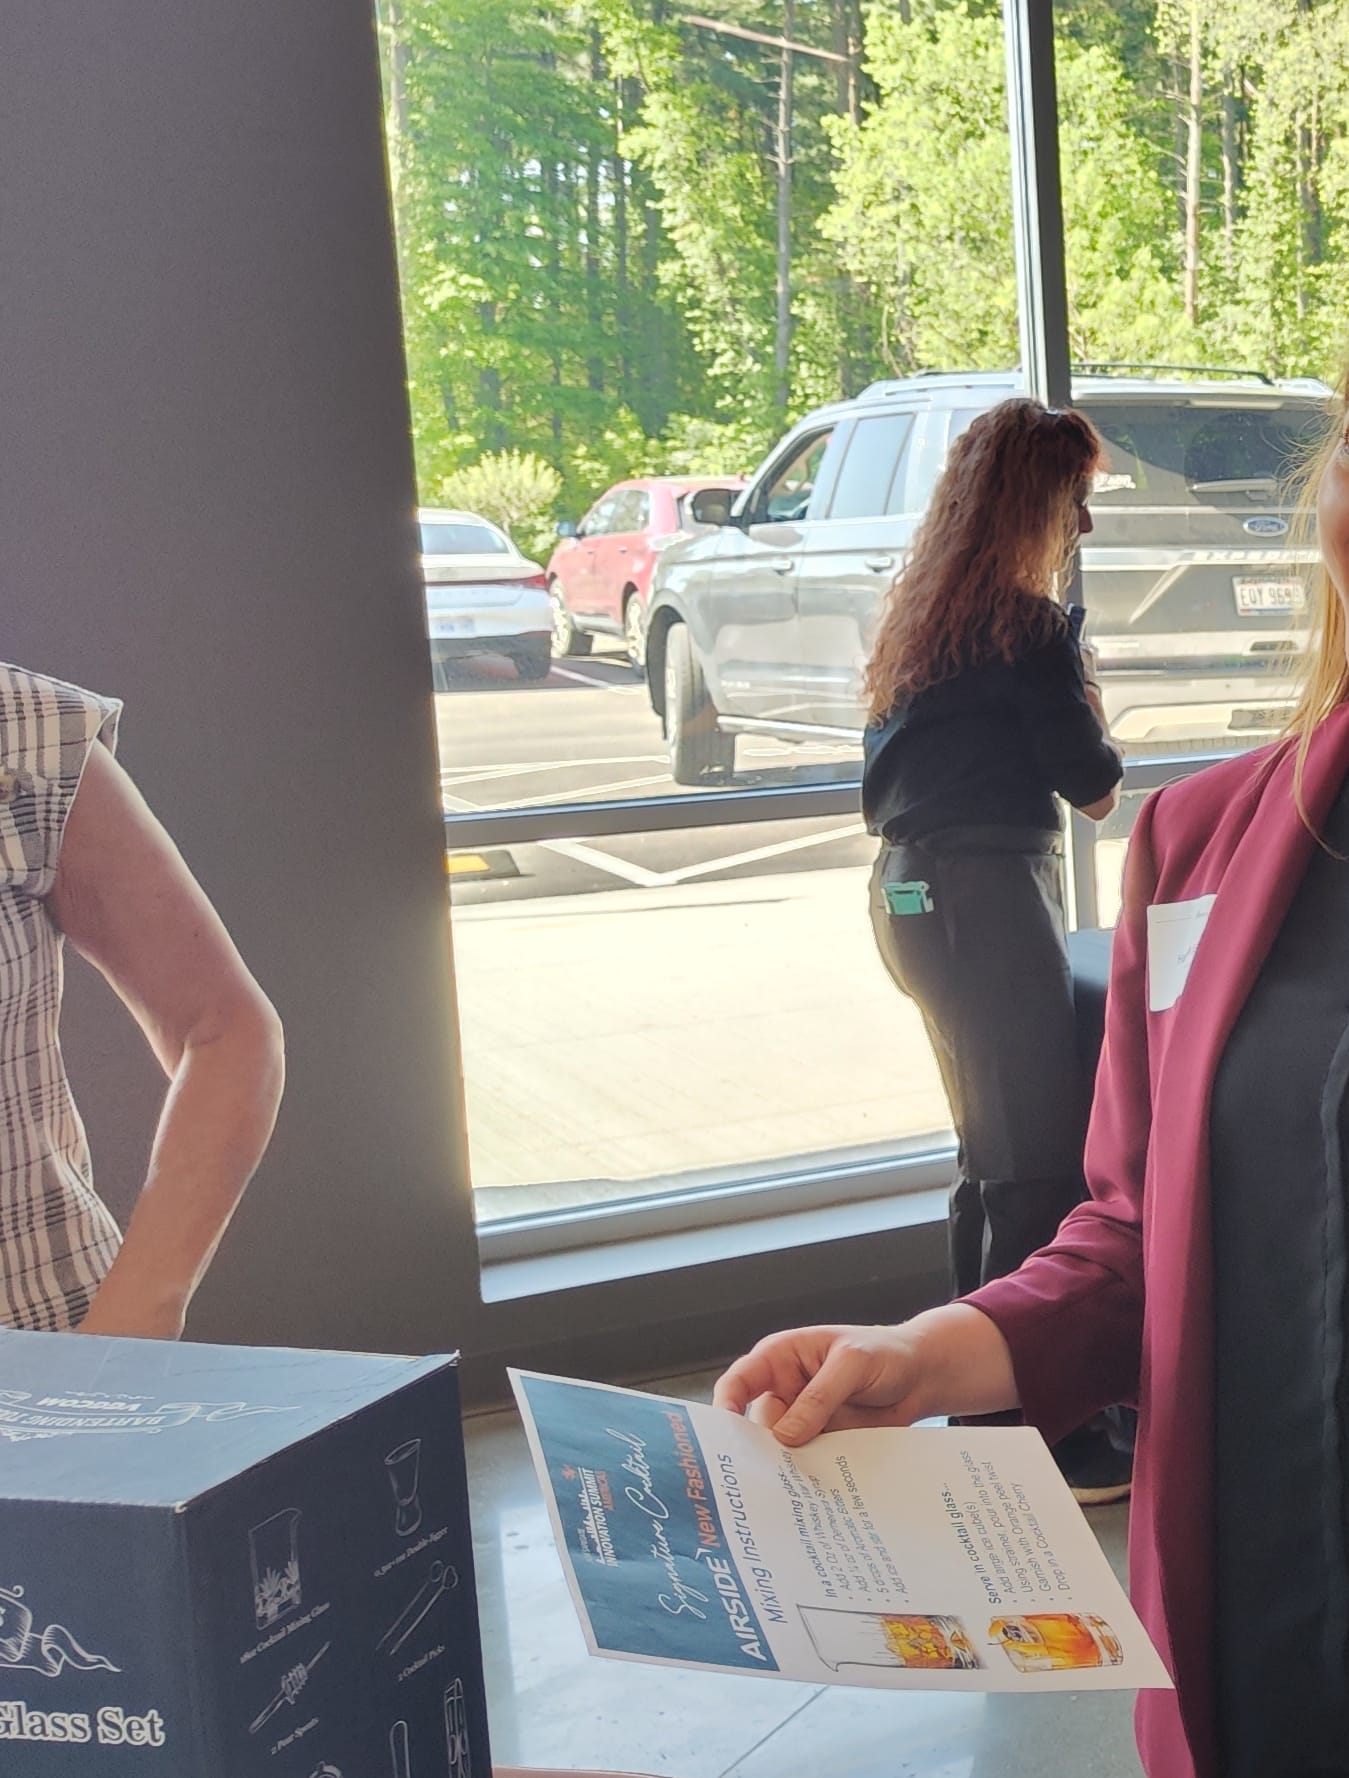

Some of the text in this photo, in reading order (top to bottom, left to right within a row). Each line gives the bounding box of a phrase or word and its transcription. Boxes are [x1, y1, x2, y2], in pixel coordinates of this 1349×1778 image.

[21, 1414, 167, 1427] BARTENDING
[959, 1450, 980, 1473] glass
[835, 1456, 858, 1492] seconds
[968, 1474, 983, 1488] the
[850, 1495, 866, 1510] few
[976, 1490, 992, 1506] into
[1011, 1482, 1030, 1511] Cherry
[582, 1467, 618, 1567] INNOVATION SUMMIT
[606, 1427, 709, 1620] Signature Cocktail
[792, 1500, 809, 1537] mixing
[861, 1520, 874, 1530] for
[963, 1501, 987, 1534] cube(s)
[981, 1461, 1052, 1591] Garnish with Orange peel twist
[985, 1508, 1005, 1527] pour
[660, 1410, 767, 1661] AIRSIDE New Fashioned
[717, 1453, 788, 1624] Mixing Instructions
[953, 1522, 980, 1562] cocktail
[1023, 1513, 1049, 1548] Cocktail
[873, 1547, 892, 1562] and
[979, 1537, 995, 1550] ice
[800, 1540, 827, 1577] cocktail
[974, 1565, 987, 1573] in
[833, 1574, 851, 1590] Add
[854, 1576, 871, 1592] Add
[892, 1578, 908, 1593] Add
[980, 1576, 1002, 1604] Serve
[1000, 1577, 1016, 1594] Add
[1014, 1568, 1034, 1592] Using
[1052, 1569, 1071, 1590] Drop
[825, 1589, 838, 1598] In
[97, 1706, 165, 1747] Set
